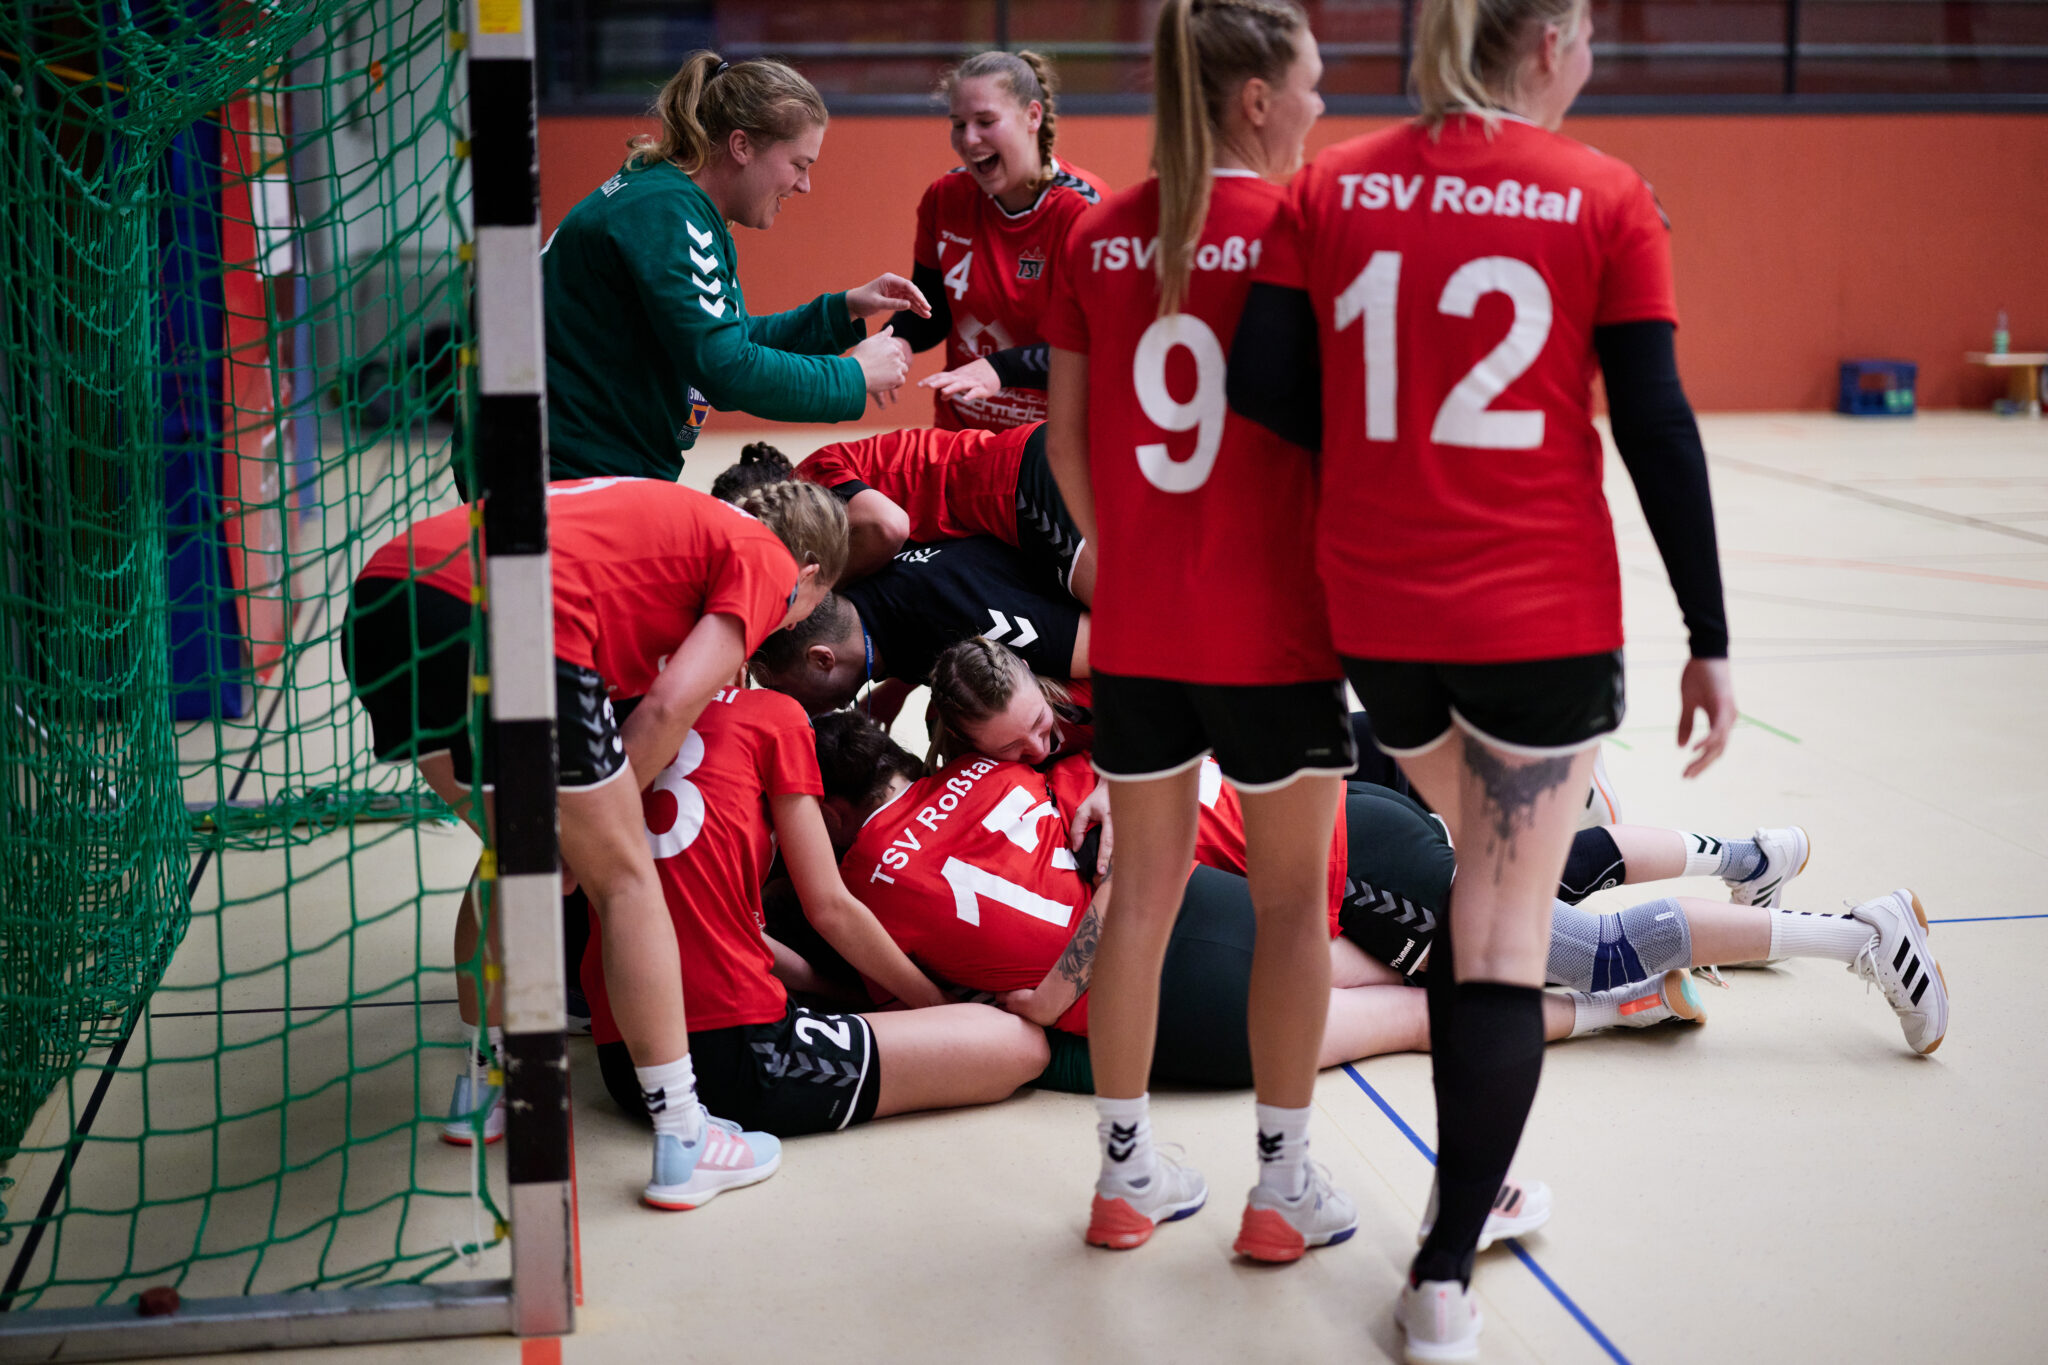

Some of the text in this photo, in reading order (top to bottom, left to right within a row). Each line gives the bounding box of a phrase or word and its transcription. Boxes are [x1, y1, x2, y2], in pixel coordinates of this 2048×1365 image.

[1338, 173, 1583, 225] TSV Roßtal
[1090, 236, 1159, 271] TSV
[1334, 251, 1553, 449] 12
[1133, 313, 1227, 493] 9
[870, 828, 921, 885] TSV
